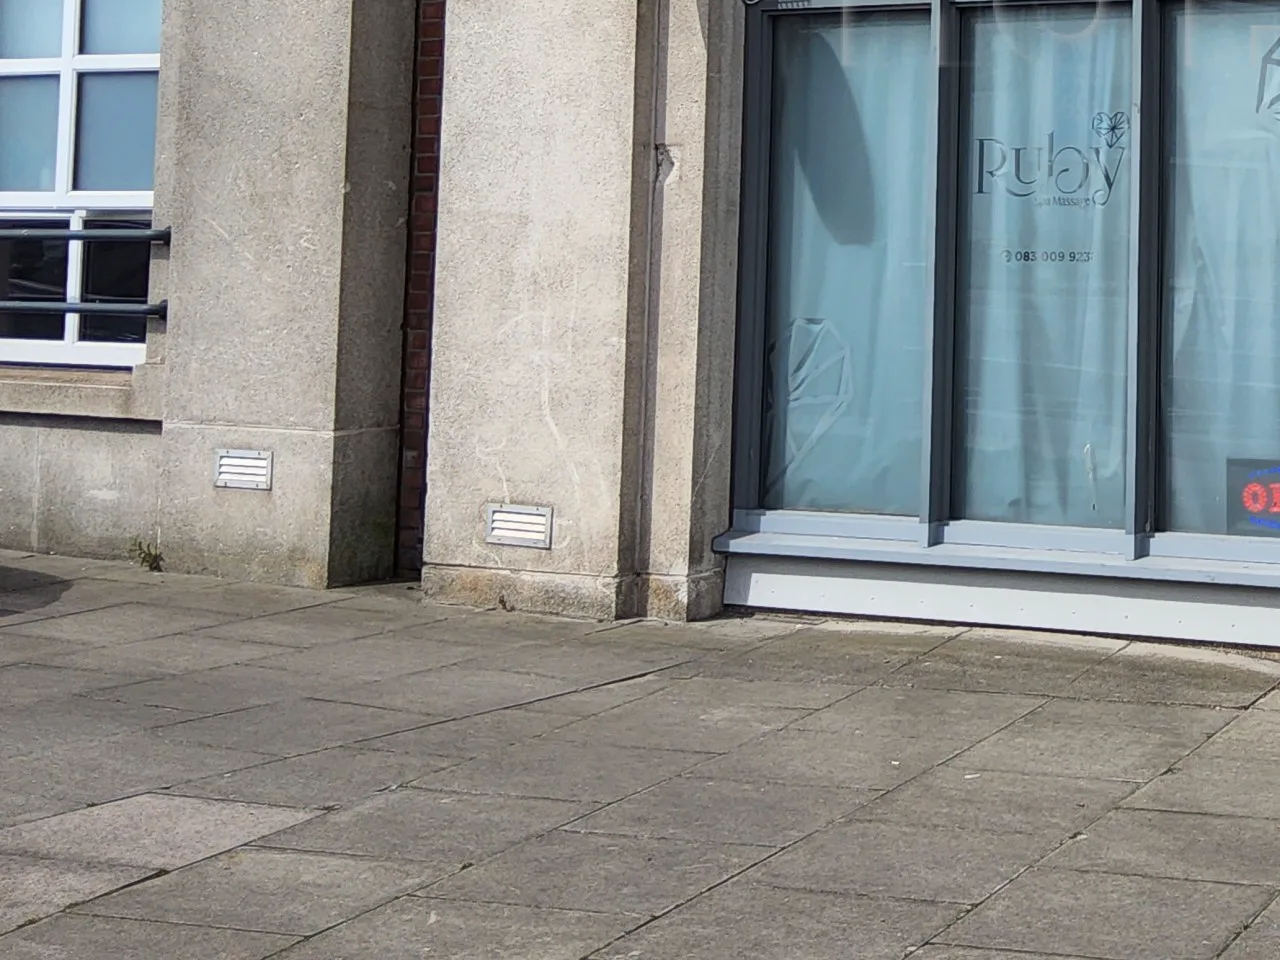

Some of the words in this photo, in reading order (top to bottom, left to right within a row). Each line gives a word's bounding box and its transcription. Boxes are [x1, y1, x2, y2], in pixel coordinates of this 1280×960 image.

[972, 130, 1127, 206] Ruby
[1015, 250, 1037, 262] 083
[1041, 251, 1065, 262] 009
